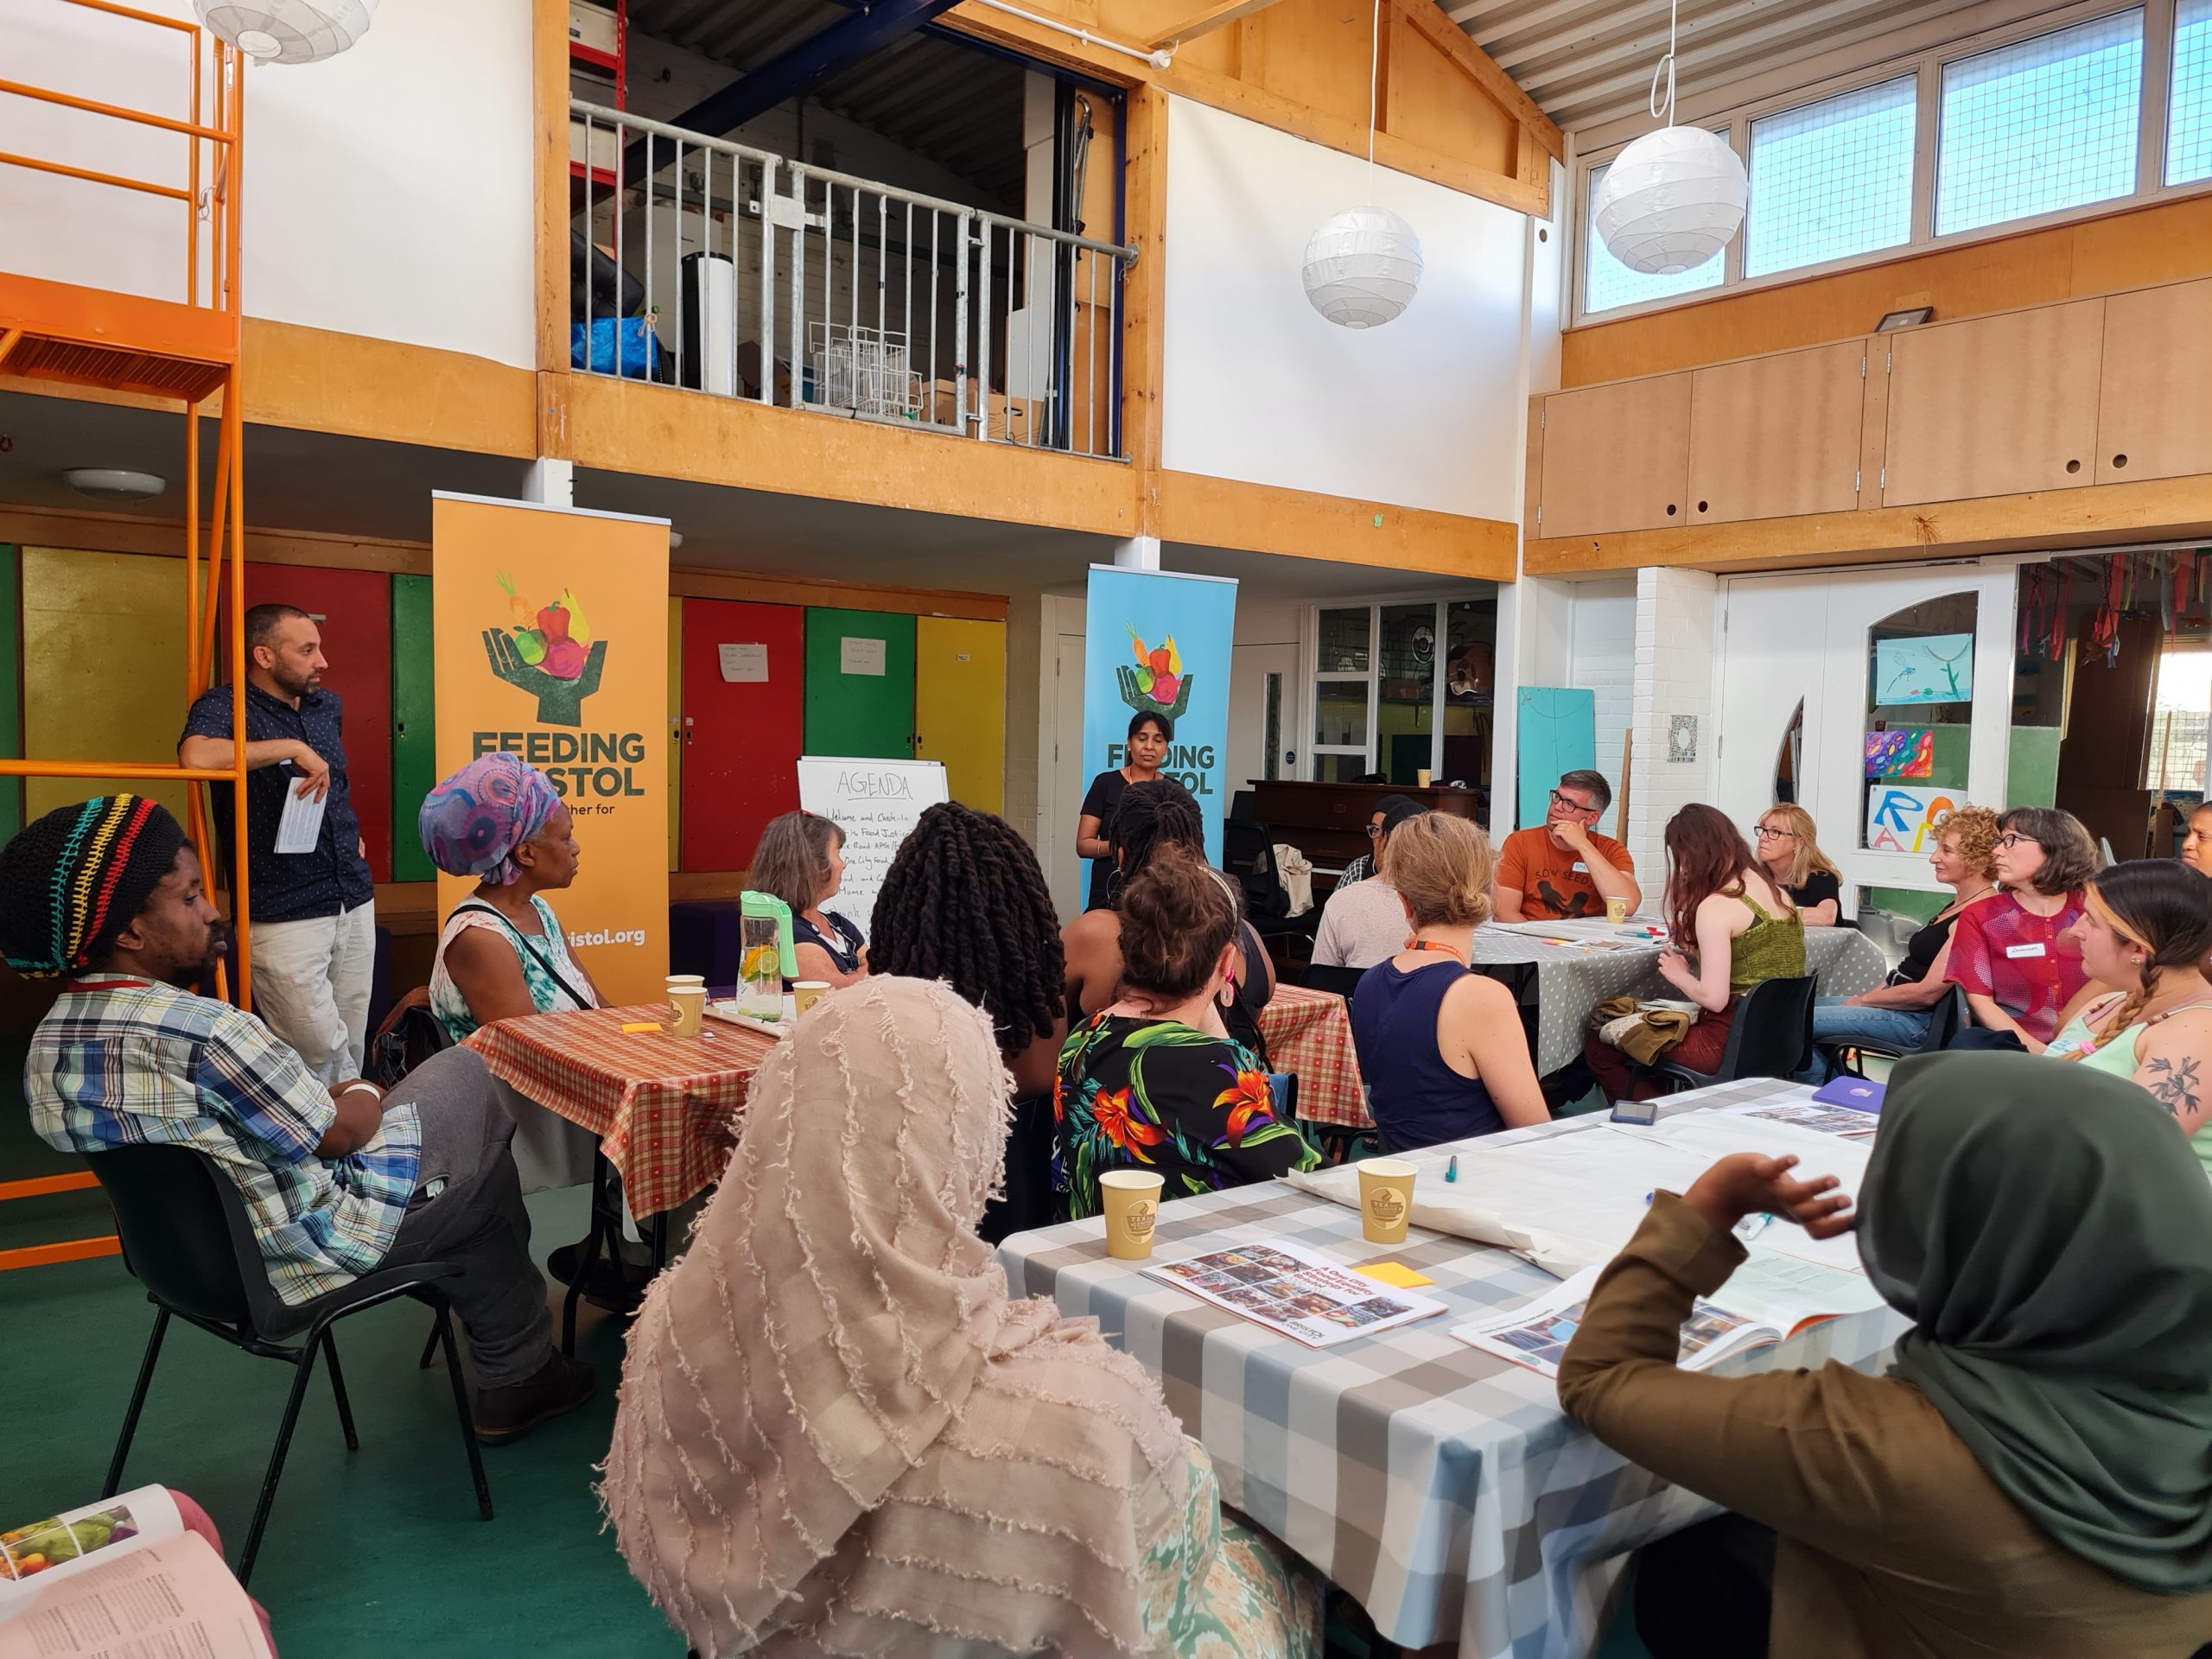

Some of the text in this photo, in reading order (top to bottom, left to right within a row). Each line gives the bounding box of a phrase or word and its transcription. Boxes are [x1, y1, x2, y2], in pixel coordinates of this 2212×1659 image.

[473, 732, 645, 763] FEEDING
[1108, 744, 1214, 769] FDING
[536, 767, 645, 797] STOL
[836, 771, 913, 800] AGENDA
[596, 804, 614, 815] for
[861, 812, 873, 823] and
[857, 856, 872, 870] City
[1535, 868, 1559, 880] SOW
